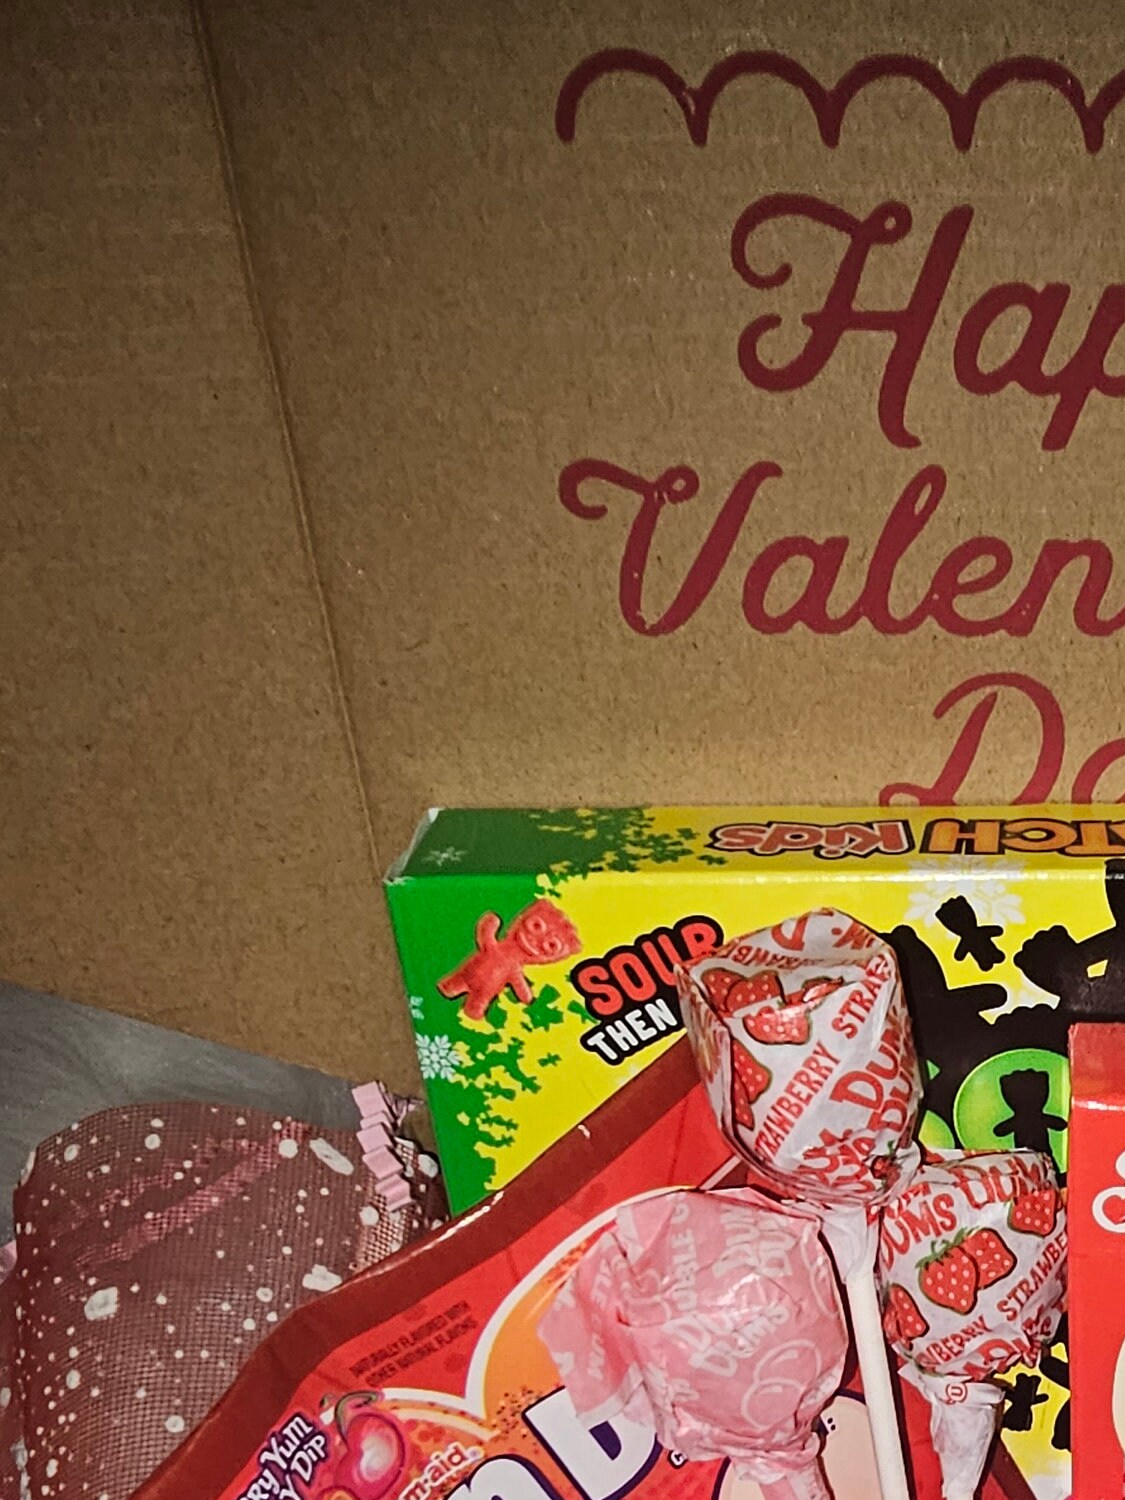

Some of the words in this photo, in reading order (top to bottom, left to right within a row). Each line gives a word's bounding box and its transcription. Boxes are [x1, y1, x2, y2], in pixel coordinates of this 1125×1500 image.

[712, 819, 908, 858] Kids
[577, 921, 719, 1018] SOUR
[587, 998, 676, 1060] THEN
